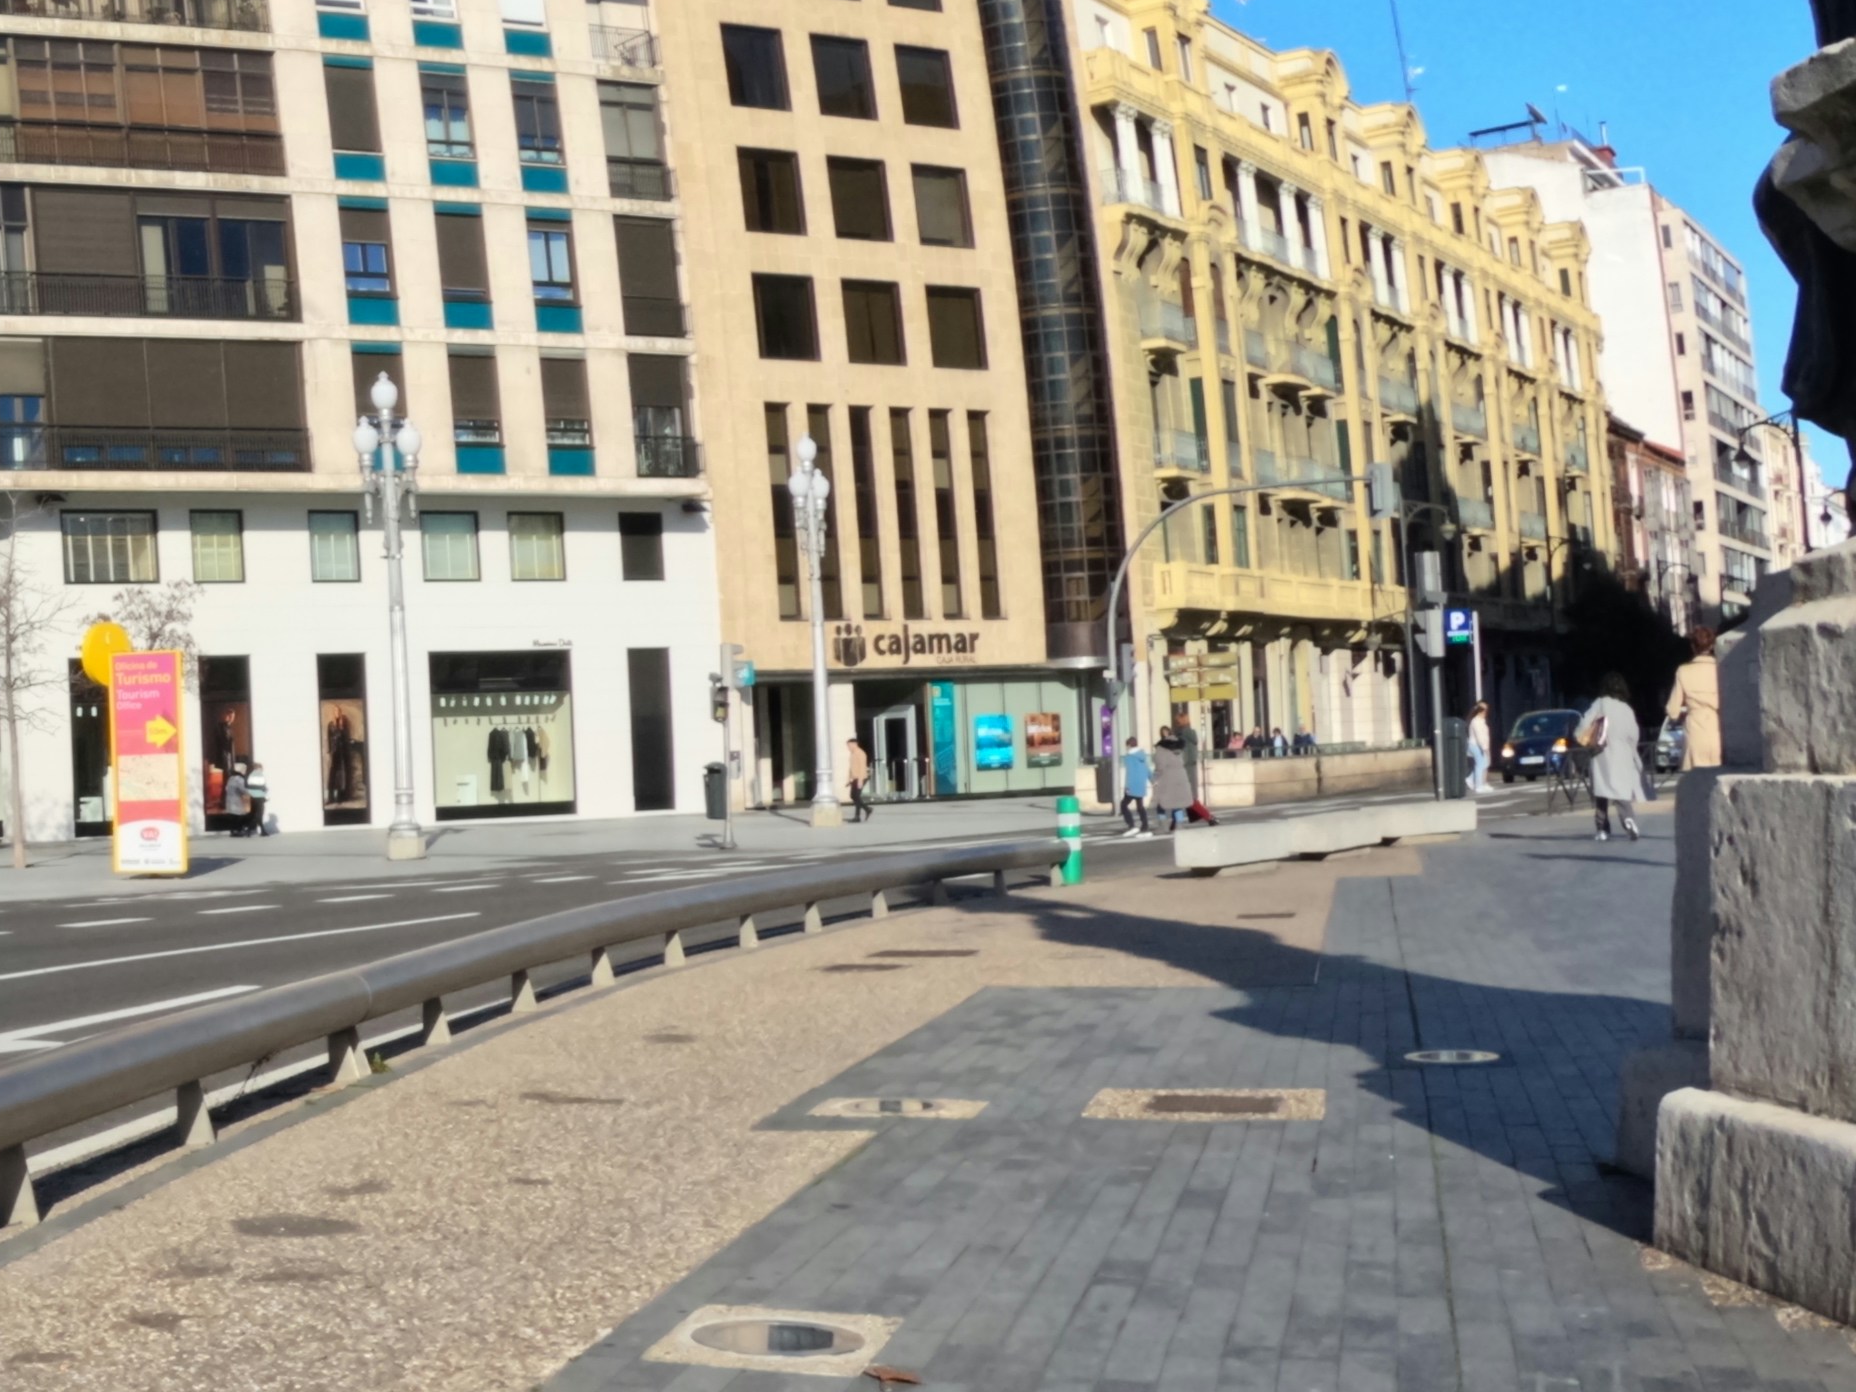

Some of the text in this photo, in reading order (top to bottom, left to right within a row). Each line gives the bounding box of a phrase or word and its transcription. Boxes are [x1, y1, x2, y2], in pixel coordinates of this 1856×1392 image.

[1450, 611, 1465, 630] P
[873, 623, 980, 665] cajamar
[116, 672, 171, 685] Turismo
[116, 689, 160, 700] Tourism
